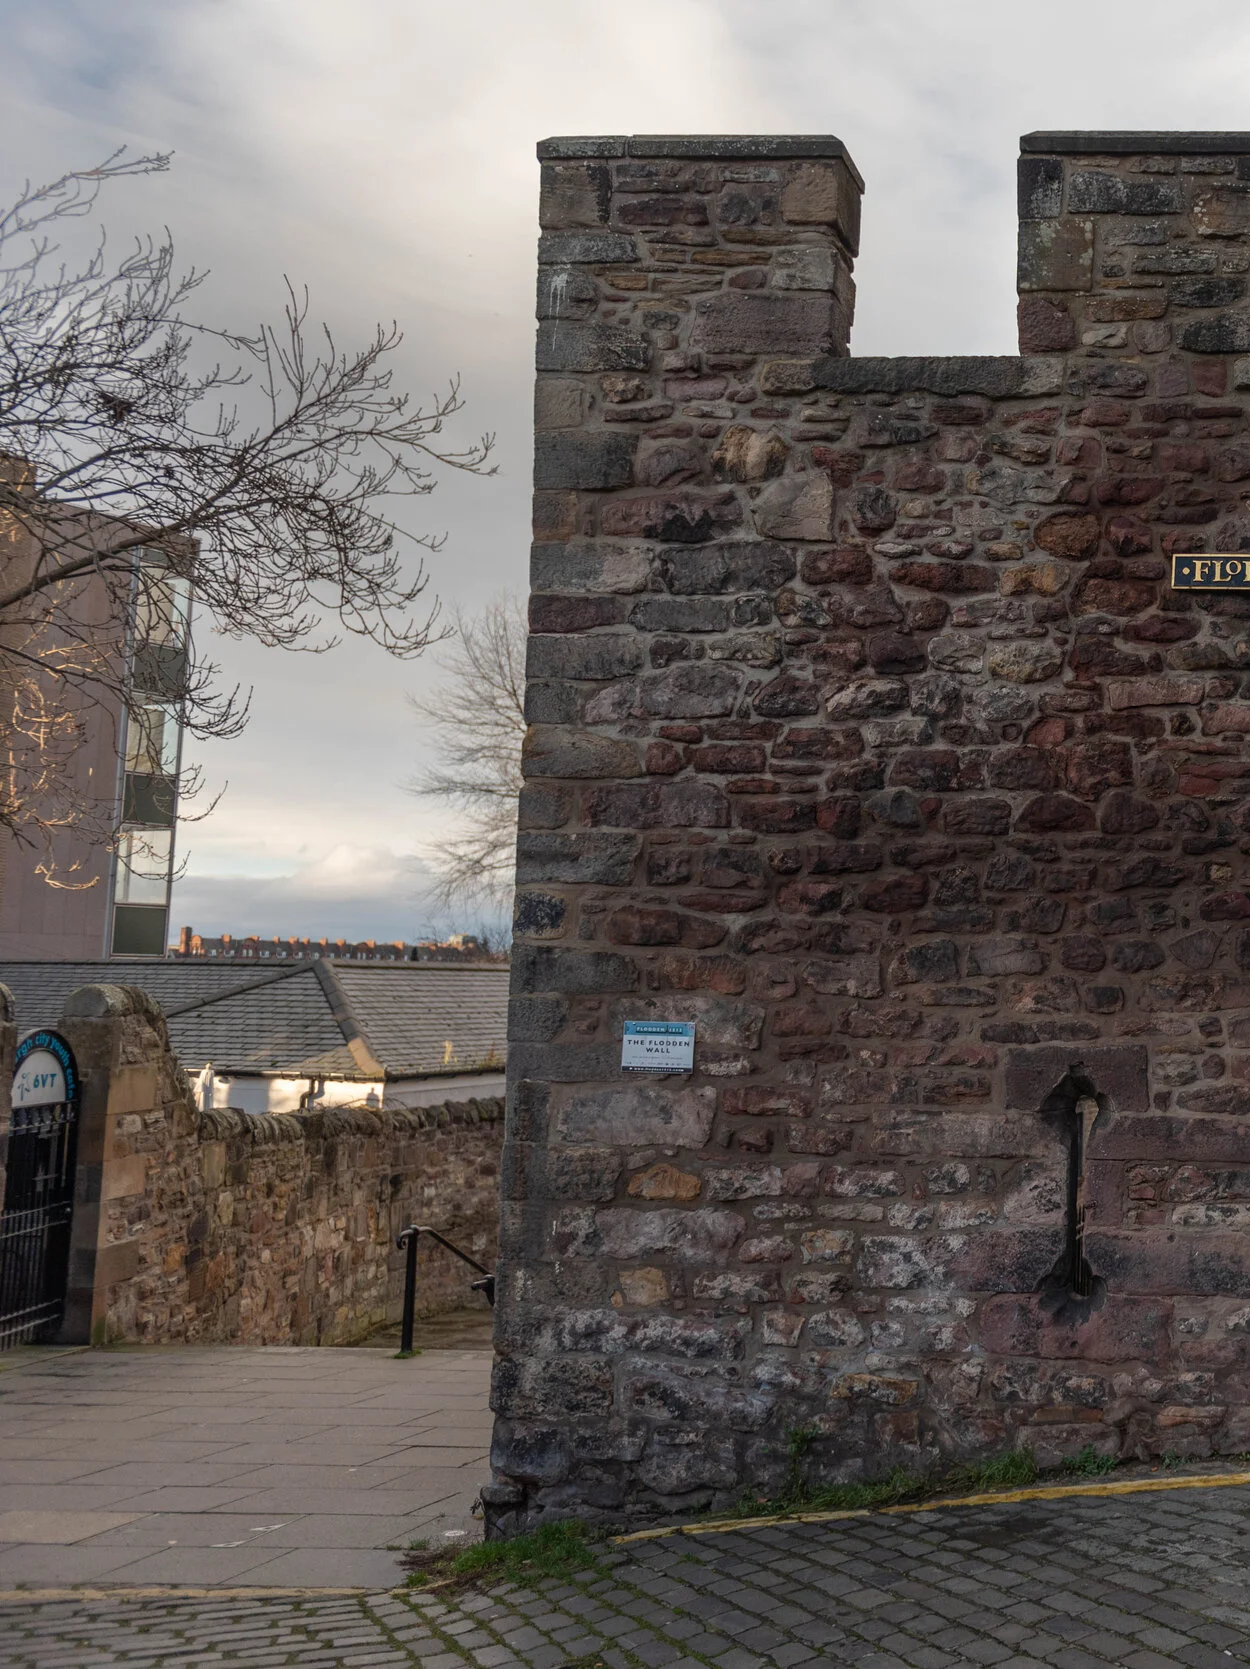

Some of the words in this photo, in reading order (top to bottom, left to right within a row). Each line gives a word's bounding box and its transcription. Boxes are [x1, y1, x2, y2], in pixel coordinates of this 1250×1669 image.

[35, 1032, 50, 1047] city
[50, 1036, 70, 1067] youth
[33, 1073, 57, 1089] 6VT
